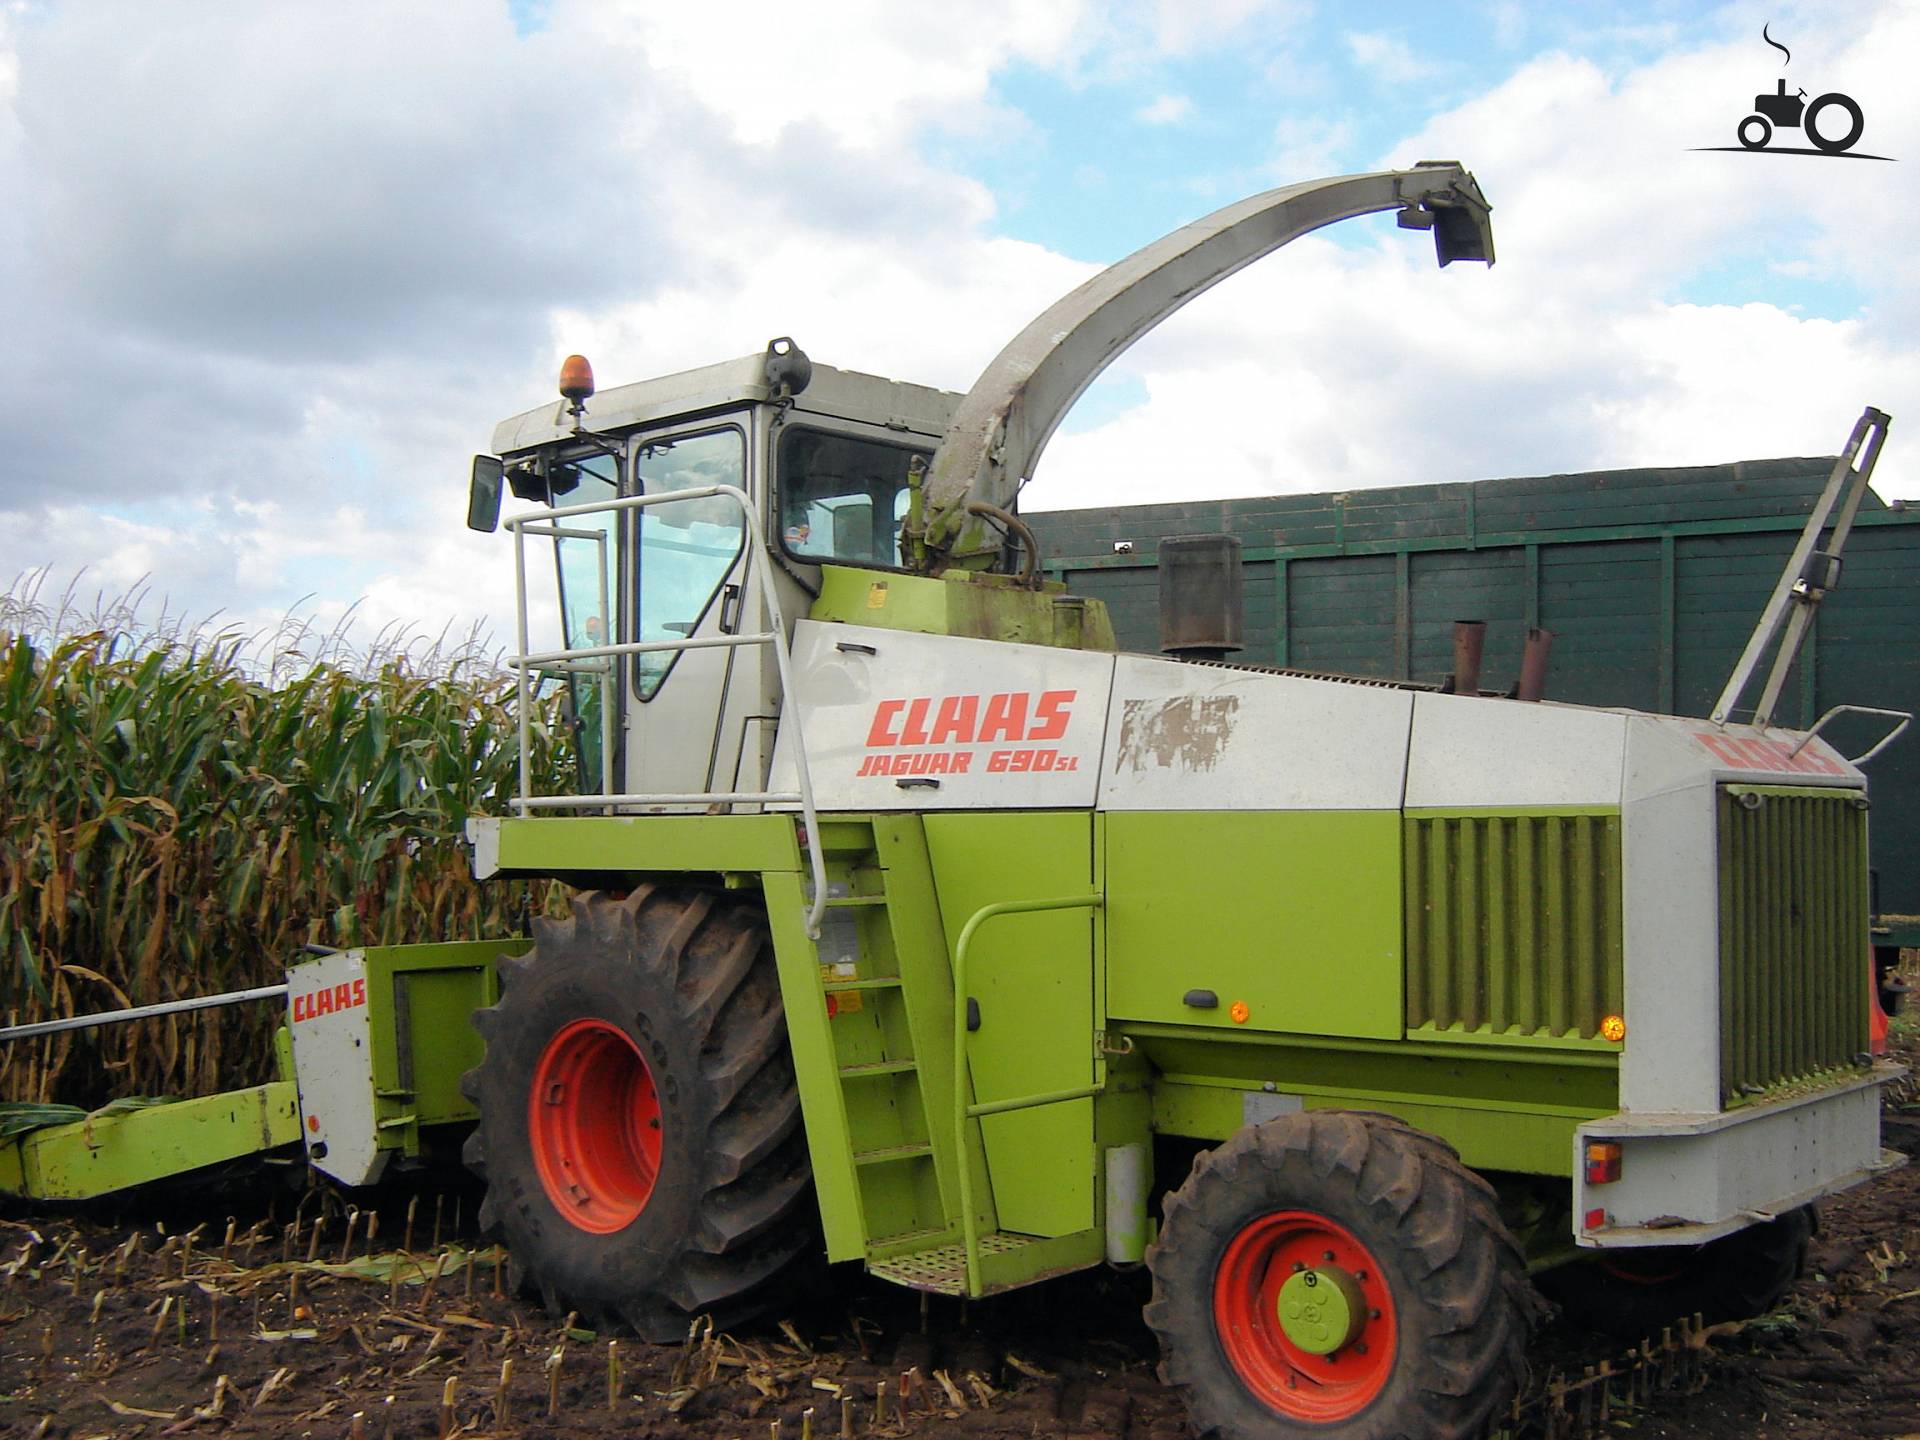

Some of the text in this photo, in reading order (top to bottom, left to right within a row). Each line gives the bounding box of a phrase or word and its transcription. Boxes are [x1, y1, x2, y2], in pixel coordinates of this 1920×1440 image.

[865, 689, 1078, 747] CLAAS
[856, 751, 973, 777] JAGUAR
[293, 978, 366, 1023] CLAAS
